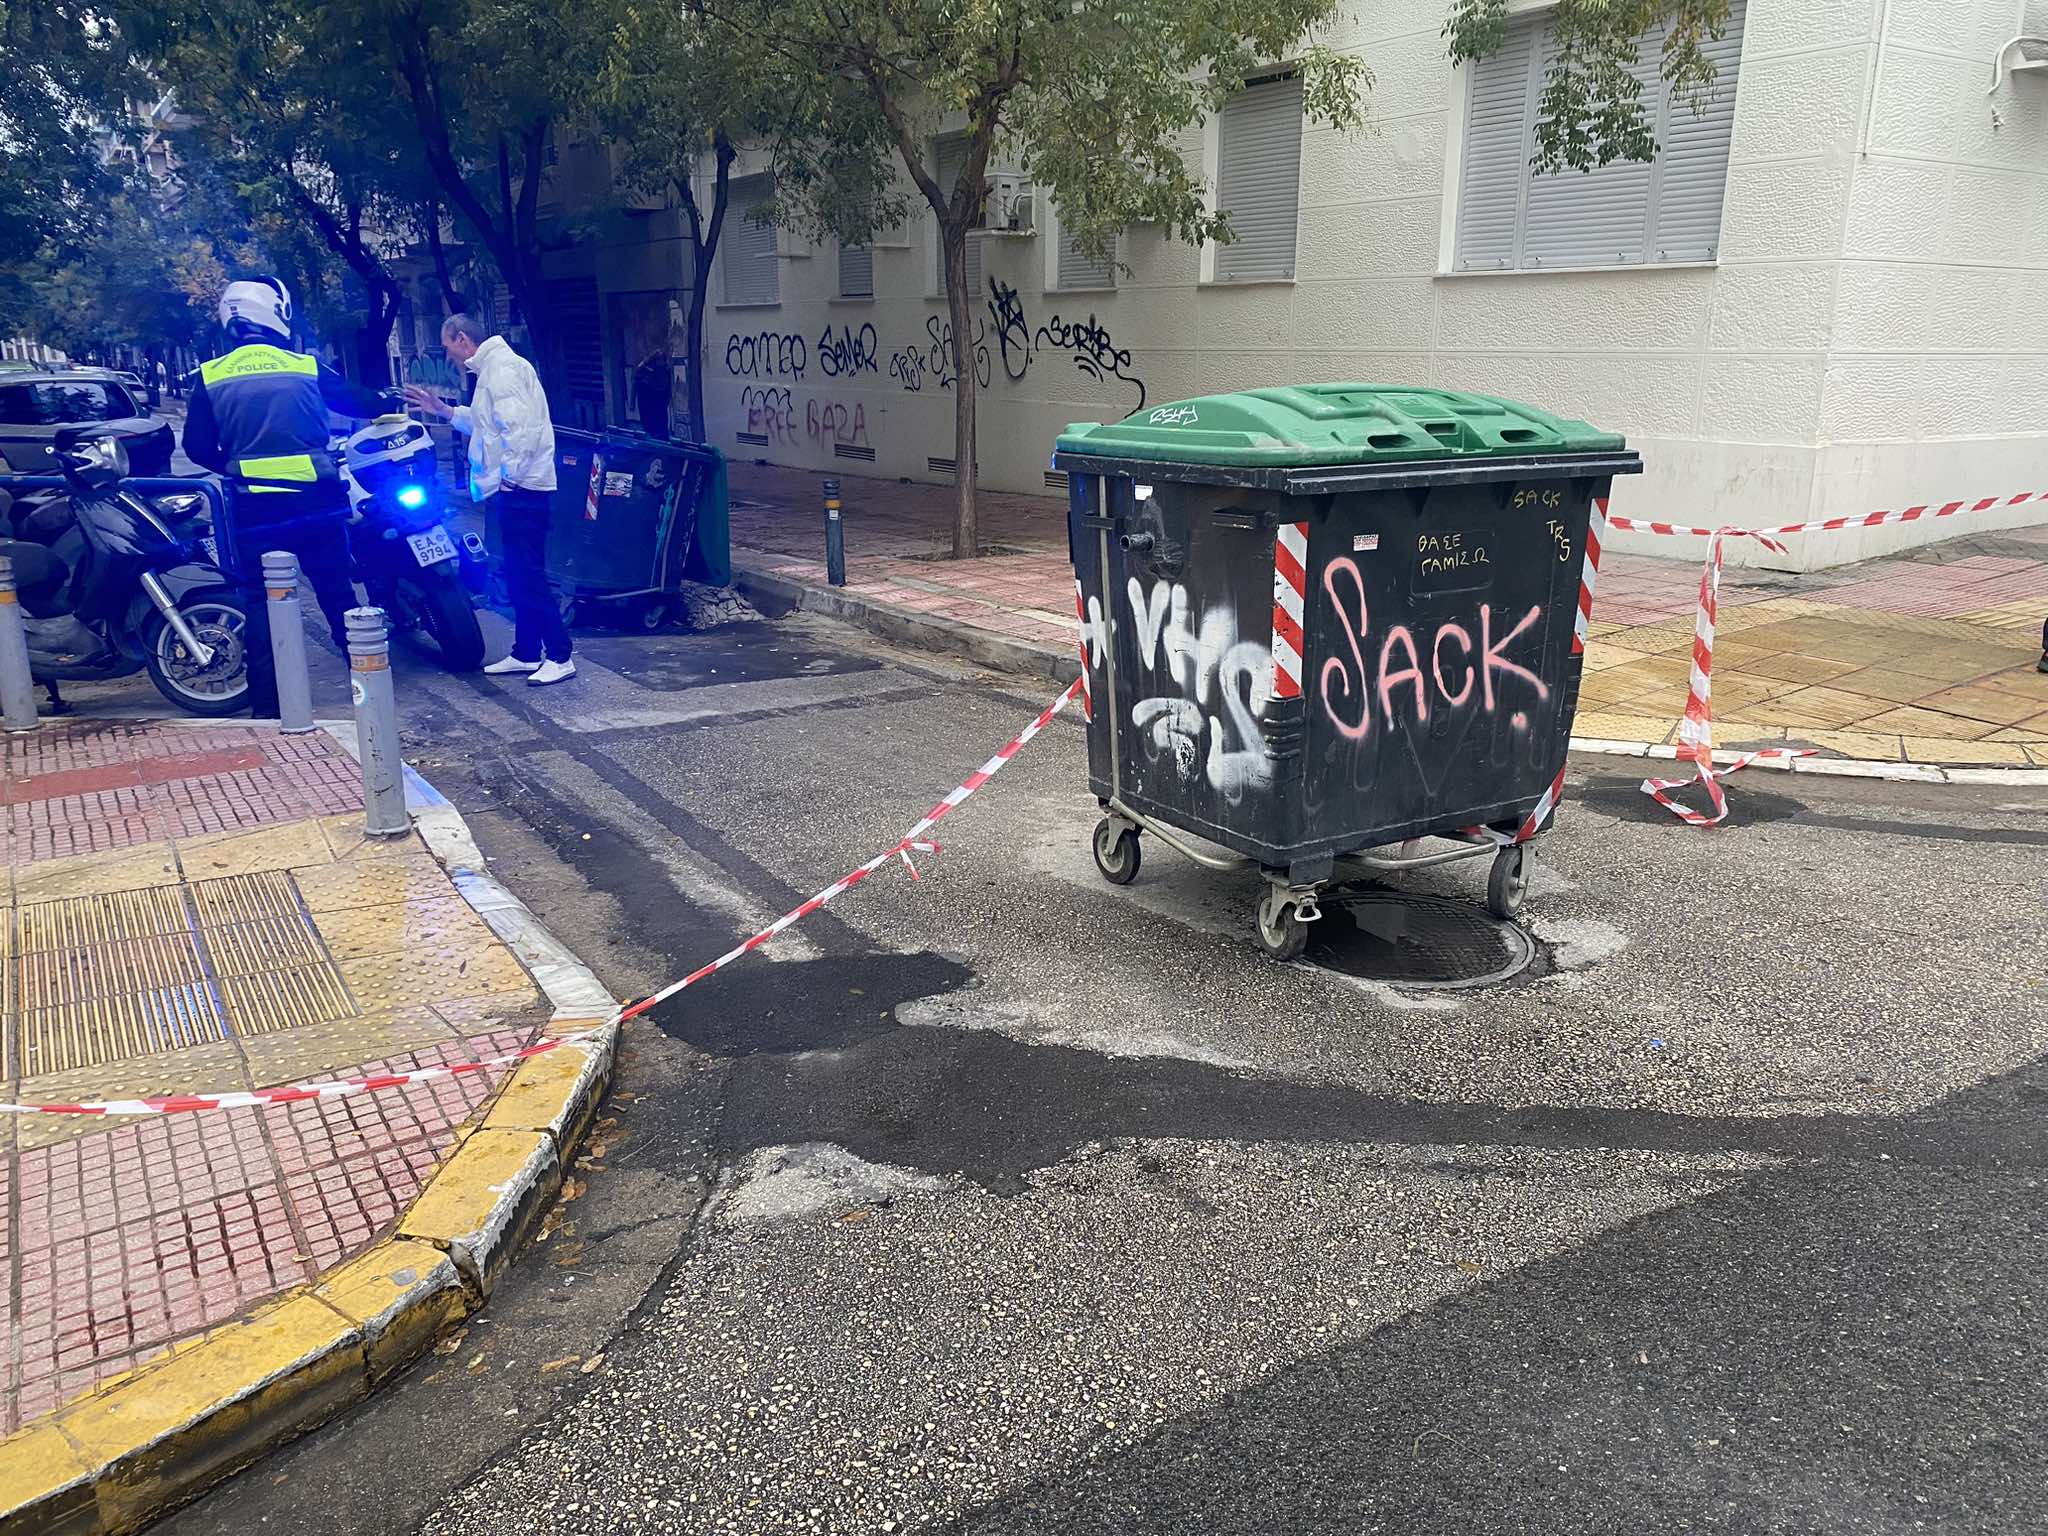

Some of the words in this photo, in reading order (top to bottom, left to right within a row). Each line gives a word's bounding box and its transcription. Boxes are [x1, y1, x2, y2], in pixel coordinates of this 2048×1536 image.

[237, 362, 279, 373] POLICE
[1514, 490, 1561, 509] SACK
[420, 543, 451, 562] 9794
